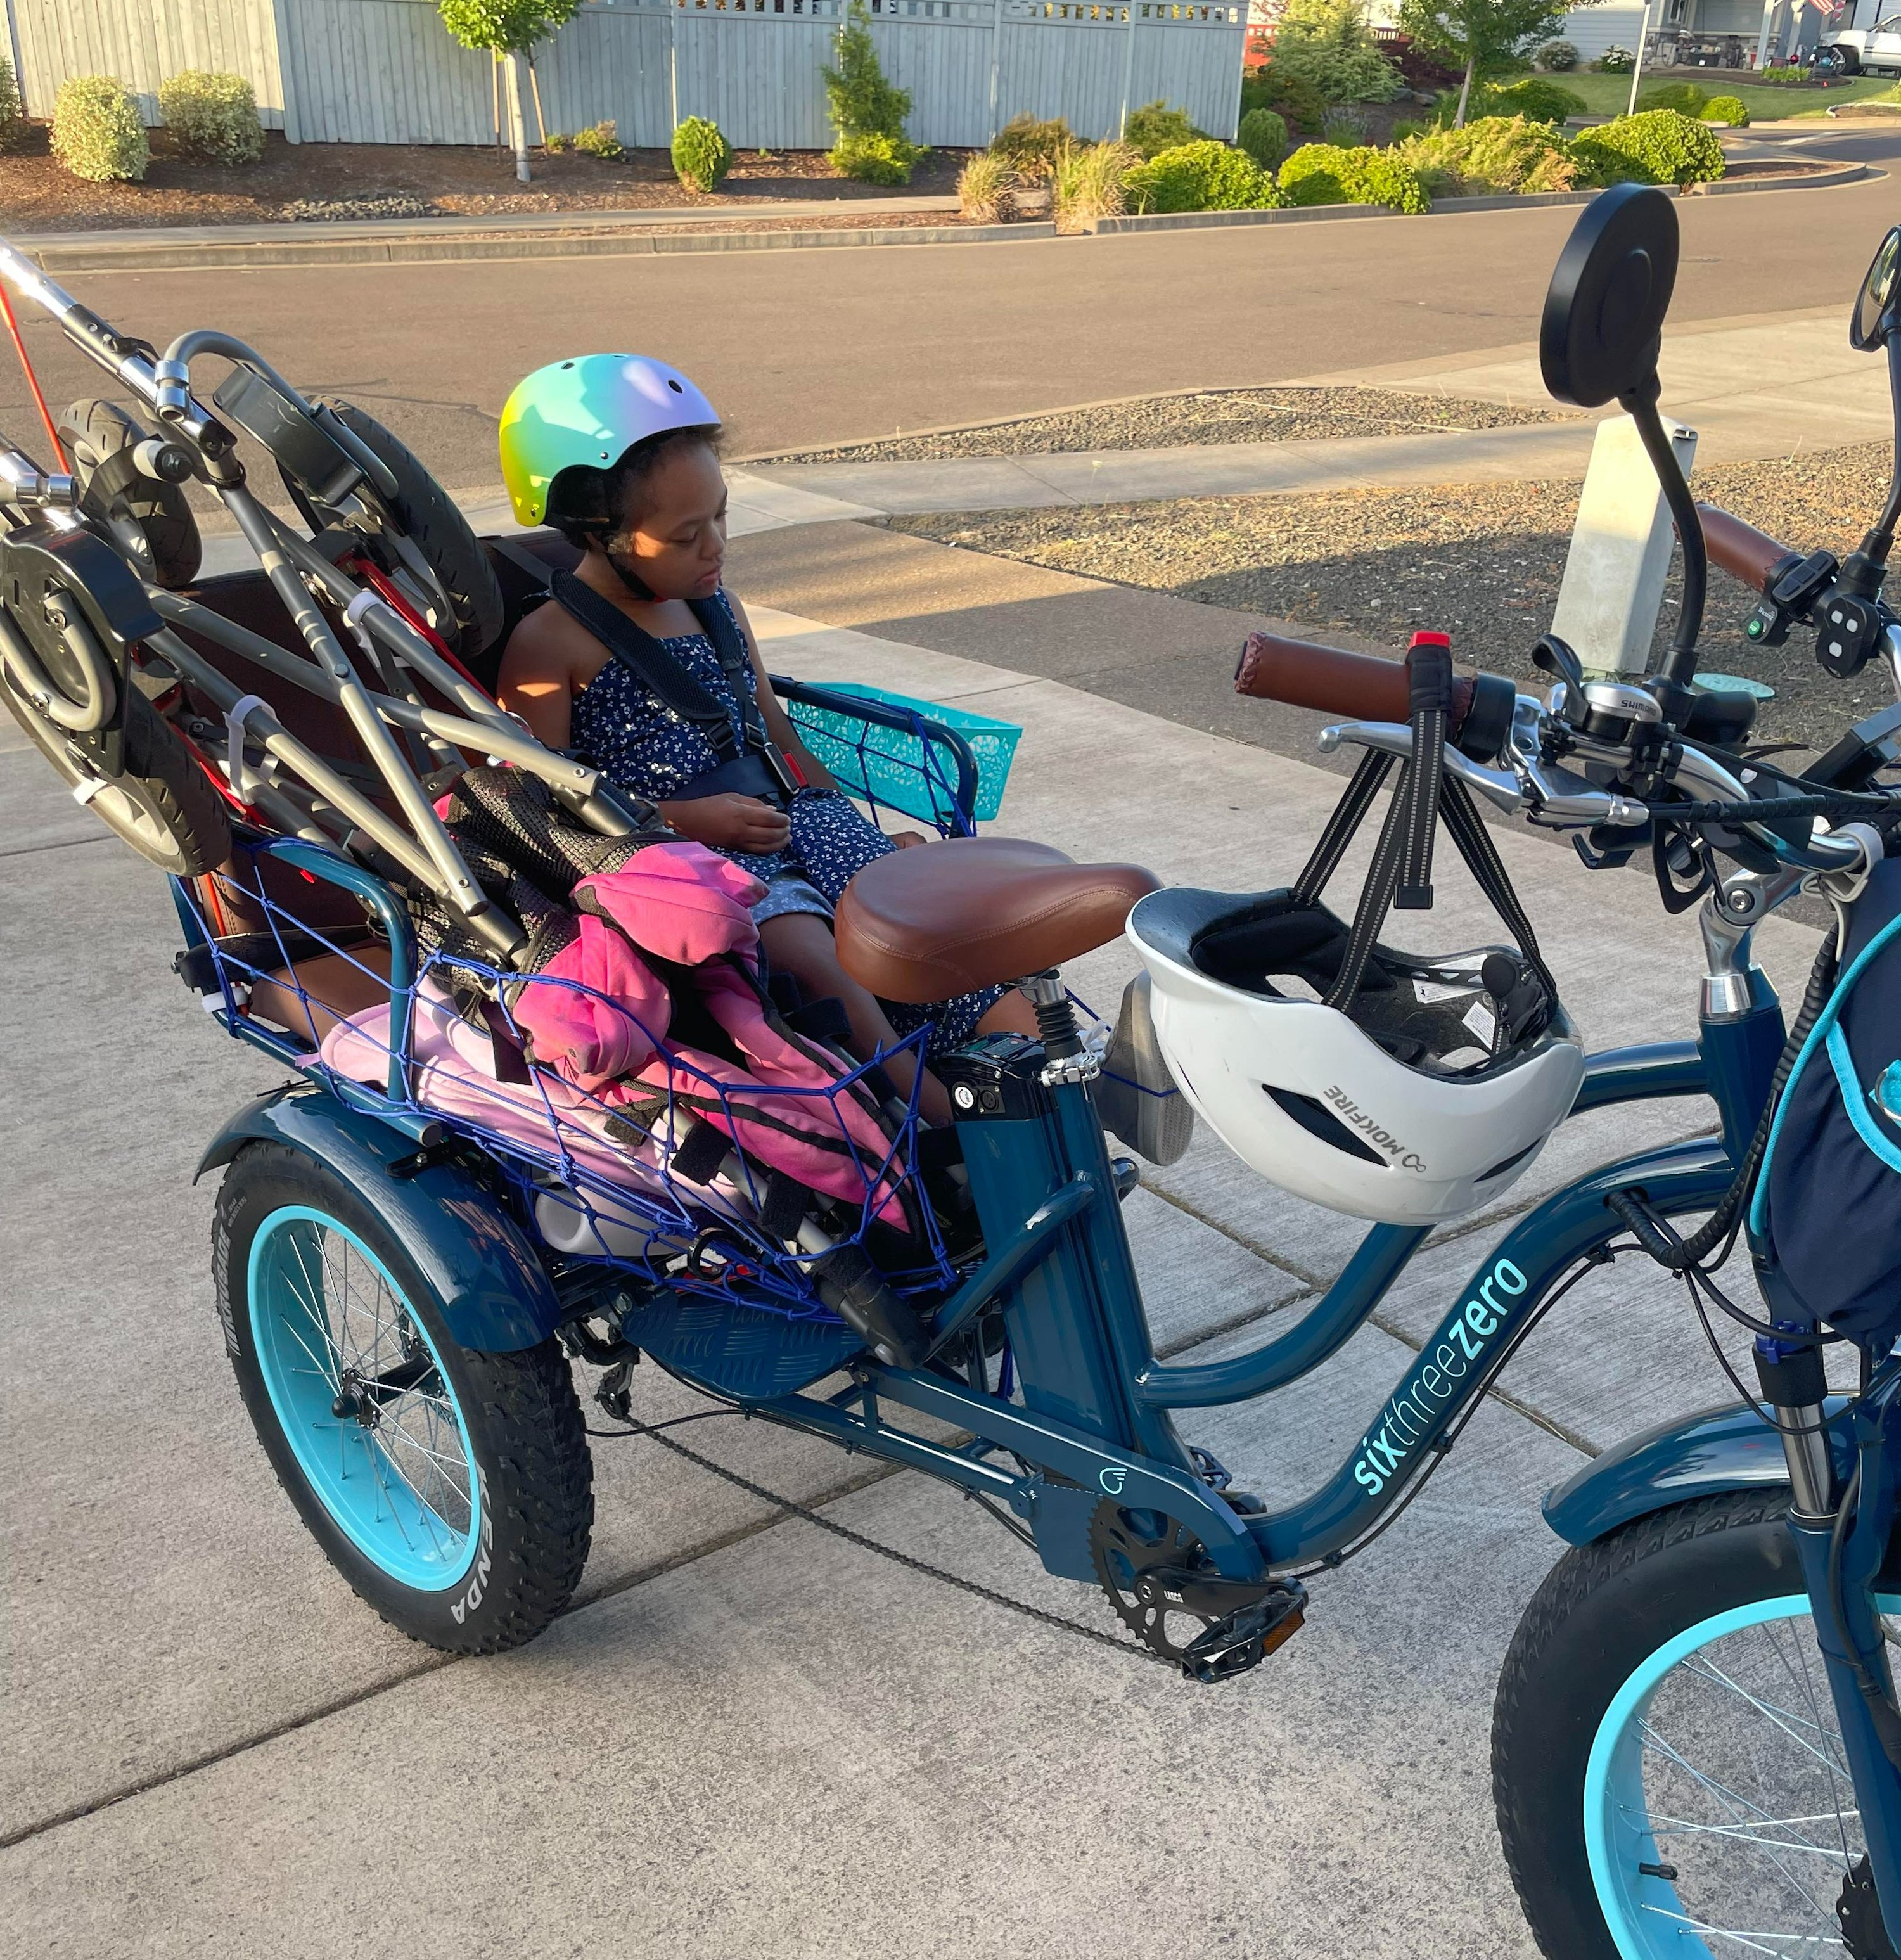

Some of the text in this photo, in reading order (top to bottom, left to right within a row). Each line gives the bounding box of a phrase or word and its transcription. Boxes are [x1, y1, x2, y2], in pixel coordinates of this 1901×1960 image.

[1323, 1085, 1405, 1155] MOKFIRE
[1354, 1258, 1528, 1496] sixthreezero
[450, 1459, 493, 1625] KENDA
